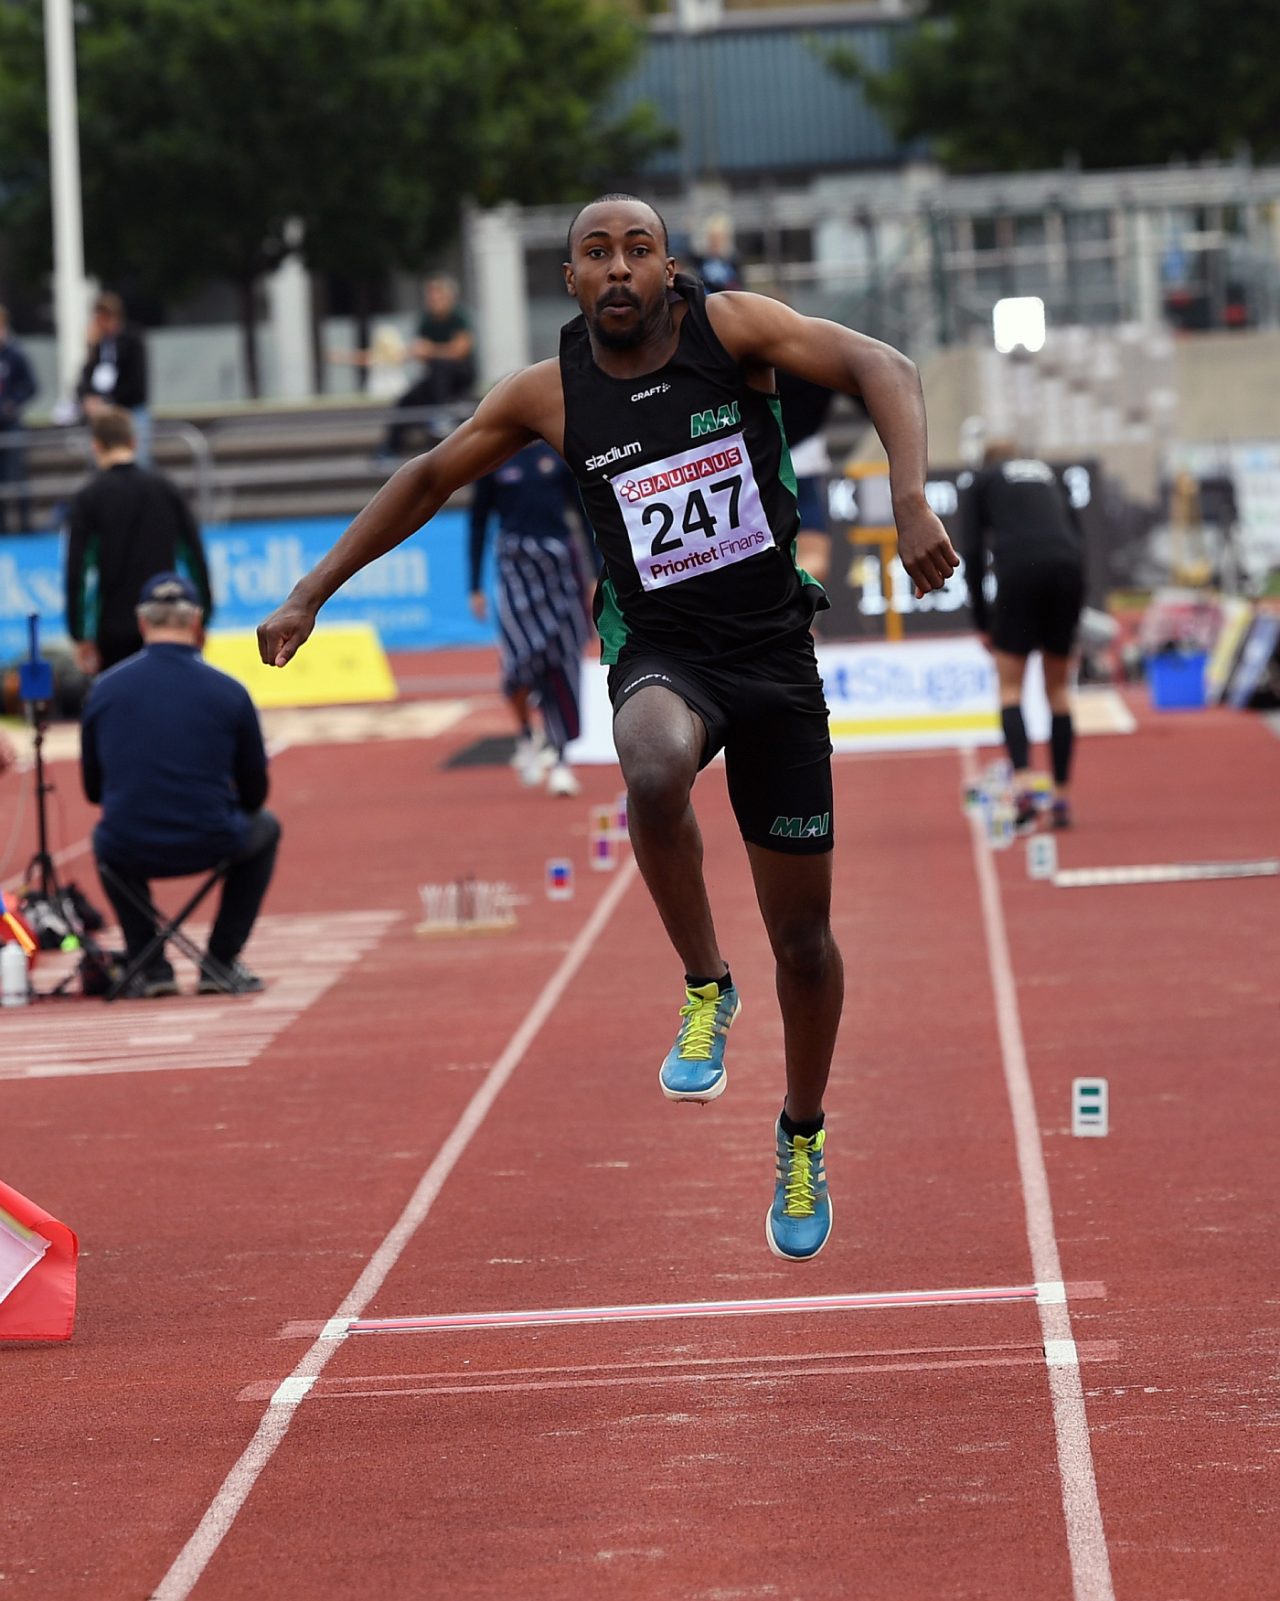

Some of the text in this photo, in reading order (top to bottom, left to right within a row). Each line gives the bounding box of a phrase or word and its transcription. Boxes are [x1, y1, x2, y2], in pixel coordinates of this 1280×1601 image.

[631, 386, 661, 402] CRAFT
[690, 400, 741, 438] MAI
[585, 441, 642, 471] stadium
[640, 448, 742, 494] BAUHAUS
[642, 474, 743, 556] 247
[650, 530, 765, 580] Prioritet Finans
[769, 811, 830, 838] MAI
